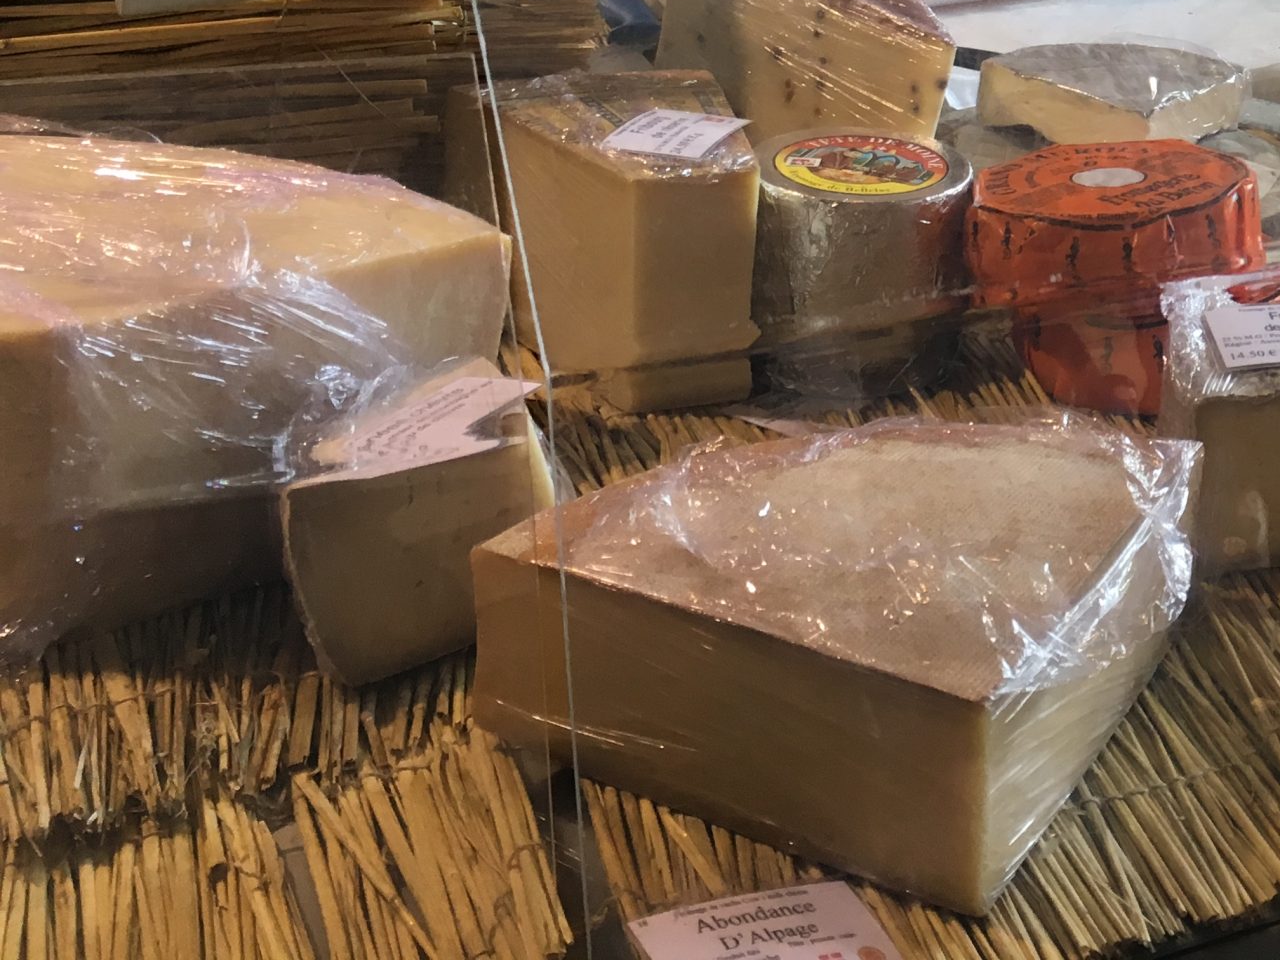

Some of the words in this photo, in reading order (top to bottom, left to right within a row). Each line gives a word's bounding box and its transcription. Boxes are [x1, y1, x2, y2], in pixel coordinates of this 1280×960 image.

[869, 137, 898, 146] DE
[1268, 349, 1277, 357] €
[697, 900, 817, 935] Abondance
[750, 922, 820, 946] Alpage
